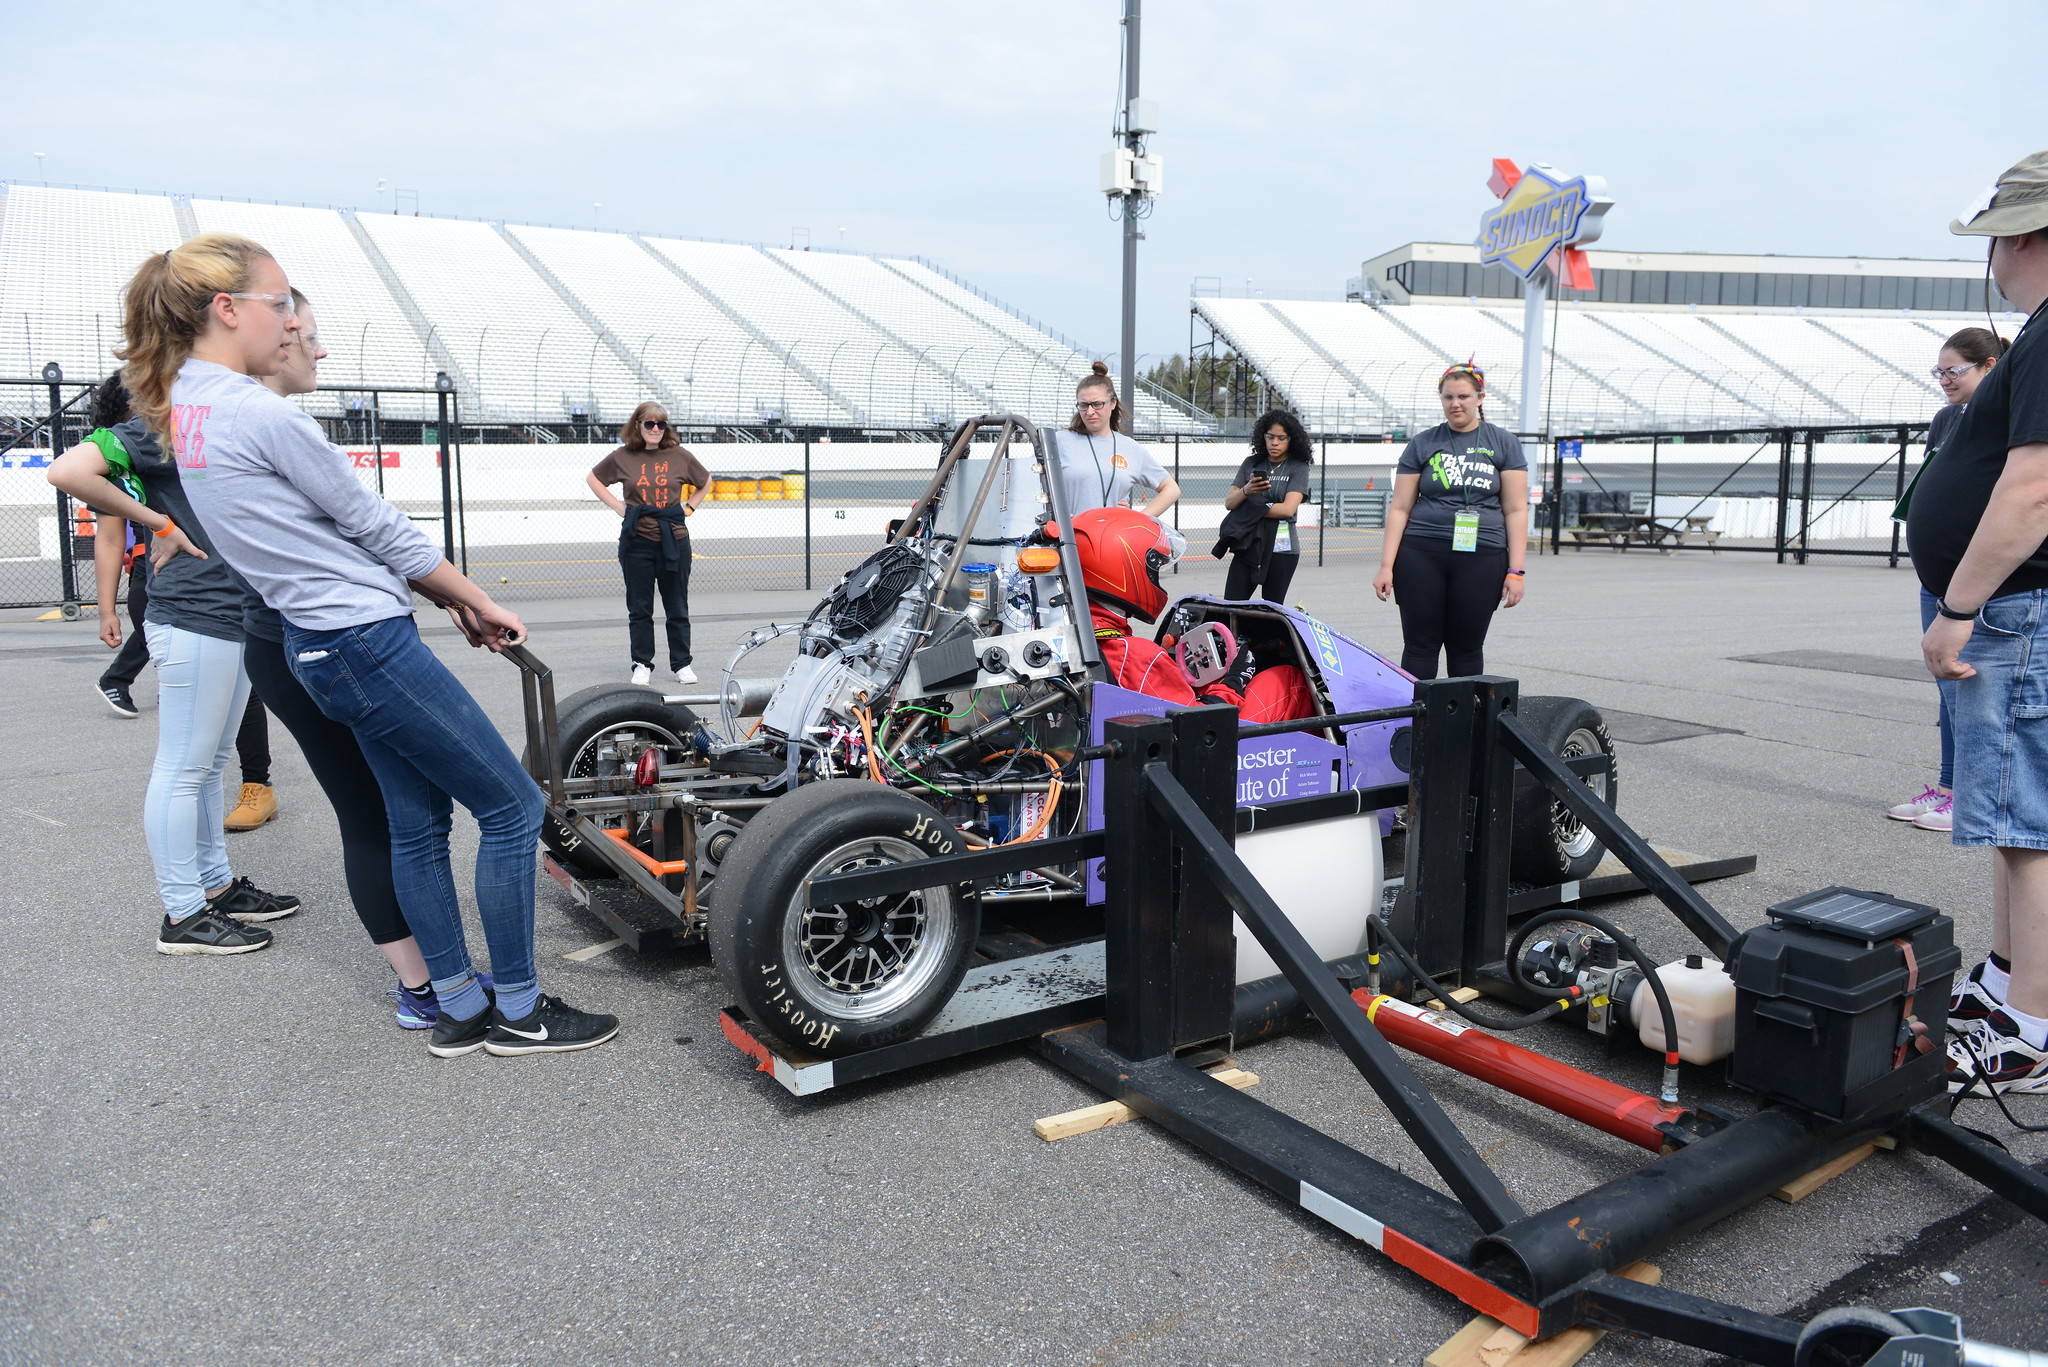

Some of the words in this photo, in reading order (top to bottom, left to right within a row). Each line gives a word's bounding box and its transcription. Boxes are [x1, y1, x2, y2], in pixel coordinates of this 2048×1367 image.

[1484, 190, 1579, 256] SUNOCO
[1448, 477, 1492, 490] TRACK
[834, 510, 846, 520] 43
[1268, 768, 1290, 798] of
